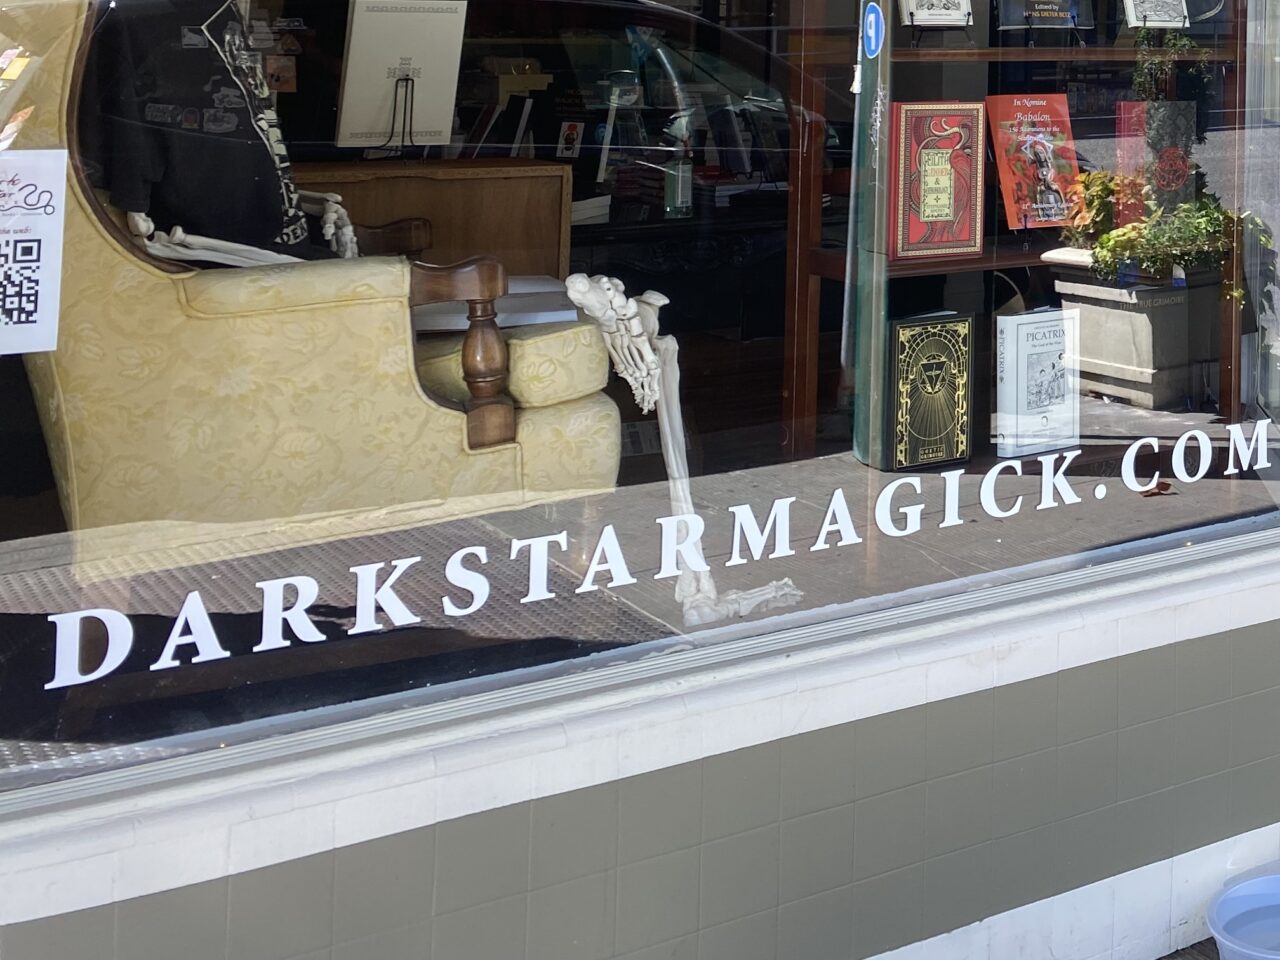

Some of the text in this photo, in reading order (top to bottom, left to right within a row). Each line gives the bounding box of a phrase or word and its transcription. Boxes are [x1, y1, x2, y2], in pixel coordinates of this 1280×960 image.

[1022, 99, 1047, 107] Nomine
[1014, 112, 1051, 121] Babalon
[1119, 301, 1134, 310] THE
[1135, 299, 1152, 309] TRUE
[1026, 328, 1066, 343] PICATRIX
[44, 419, 1272, 690] DARKSTARMAGICK.COM
